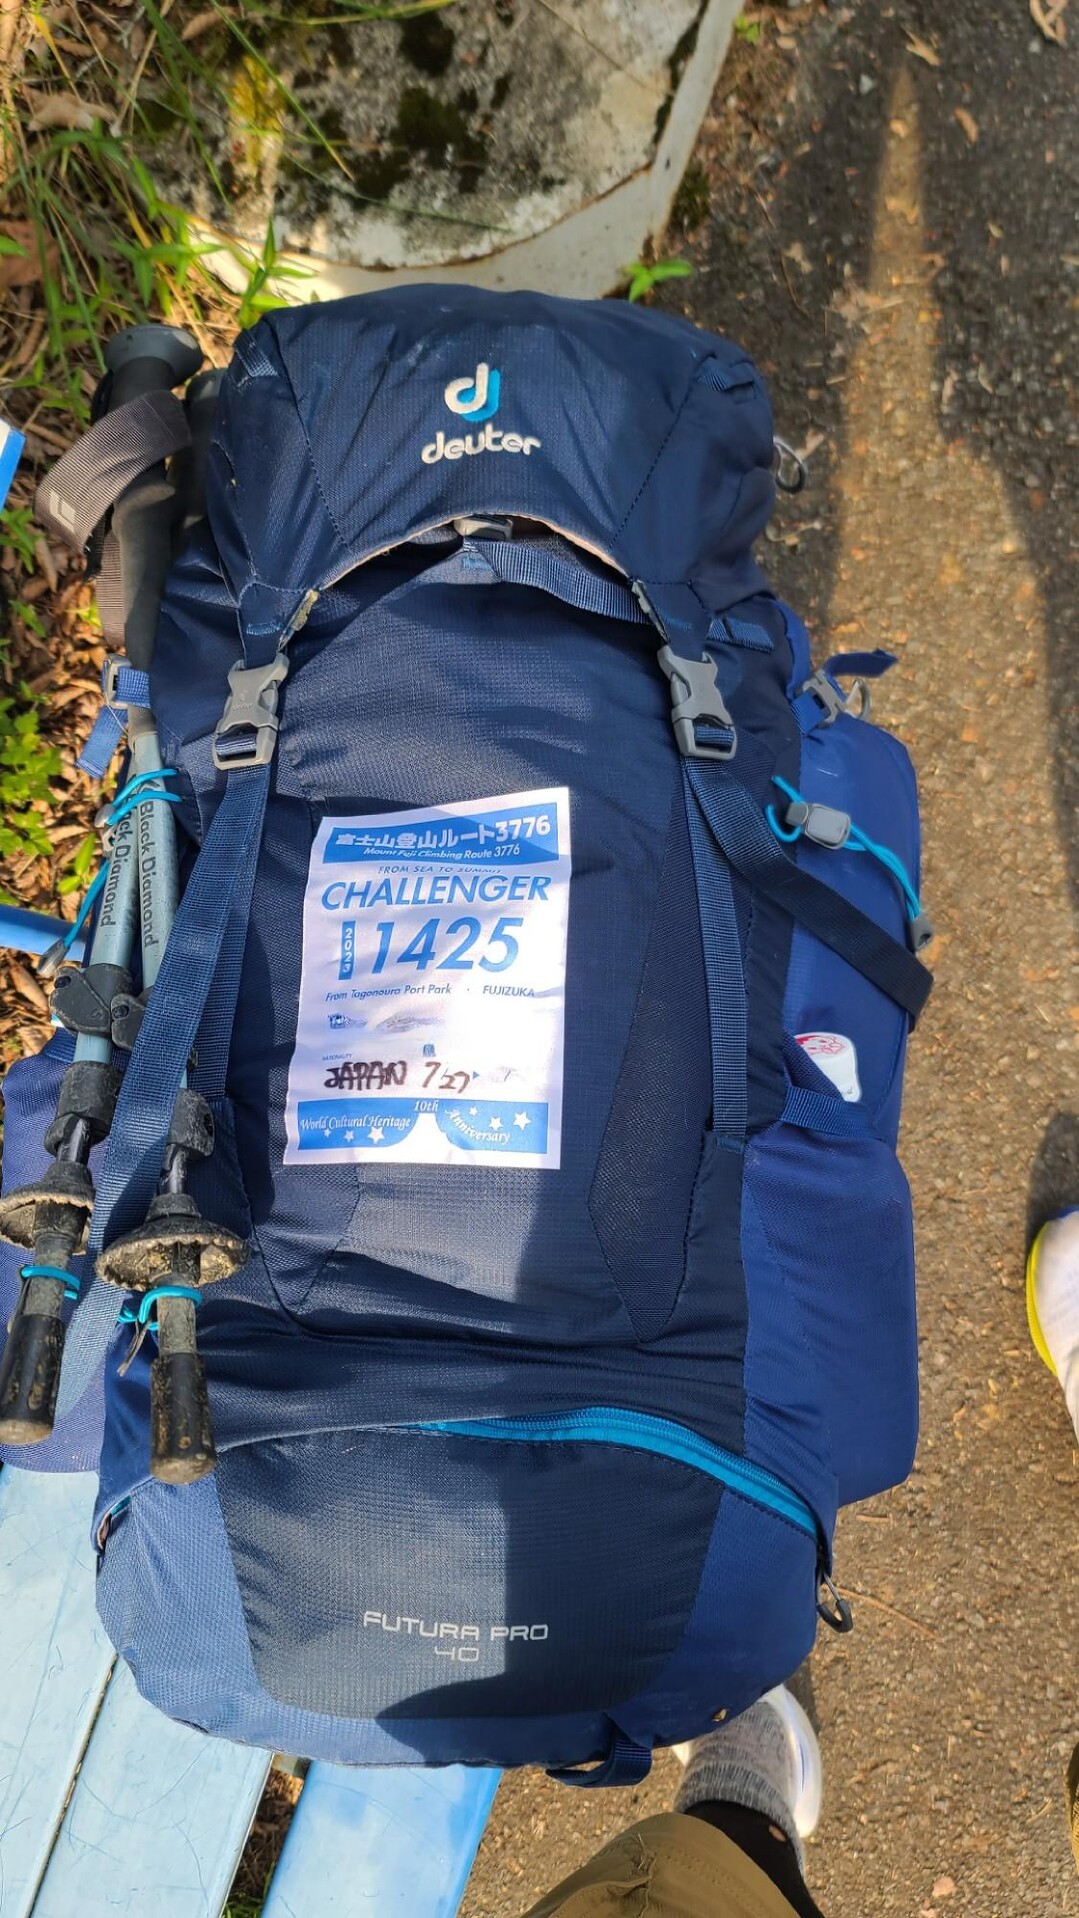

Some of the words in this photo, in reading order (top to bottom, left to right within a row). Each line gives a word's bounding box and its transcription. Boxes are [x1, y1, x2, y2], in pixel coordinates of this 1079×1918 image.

[421, 422, 541, 464] deuter
[140, 801, 155, 856] Black
[363, 847, 397, 856] Mount
[398, 849, 416, 858] Fuji
[418, 850, 463, 861] Climbing
[463, 849, 492, 859] Route
[494, 844, 520, 857] 3776
[100, 844, 131, 928] Diamond
[378, 866, 409, 874] FROM
[413, 865, 434, 873] SEA
[141, 856, 159, 948] Diamond
[321, 875, 552, 911] CHALLENGER
[343, 927, 354, 974] 2023
[371, 917, 524, 974] 1425
[325, 992, 348, 1002] From
[351, 987, 401, 1000] Tagonoura
[404, 985, 426, 995] Port
[428, 983, 453, 995] Park
[483, 985, 536, 998] FUJIZUKA
[323, 1060, 407, 1091] JAPAN
[300, 1116, 327, 1131] World
[328, 1113, 367, 1130] Cultural
[367, 1113, 411, 1131] Heritage
[414, 1100, 439, 1112] 10th
[445, 1109, 511, 1144] Anniversary
[363, 1610, 480, 1641] FUTURA
[490, 1624, 549, 1641] PRO
[434, 1646, 480, 1662] 40
